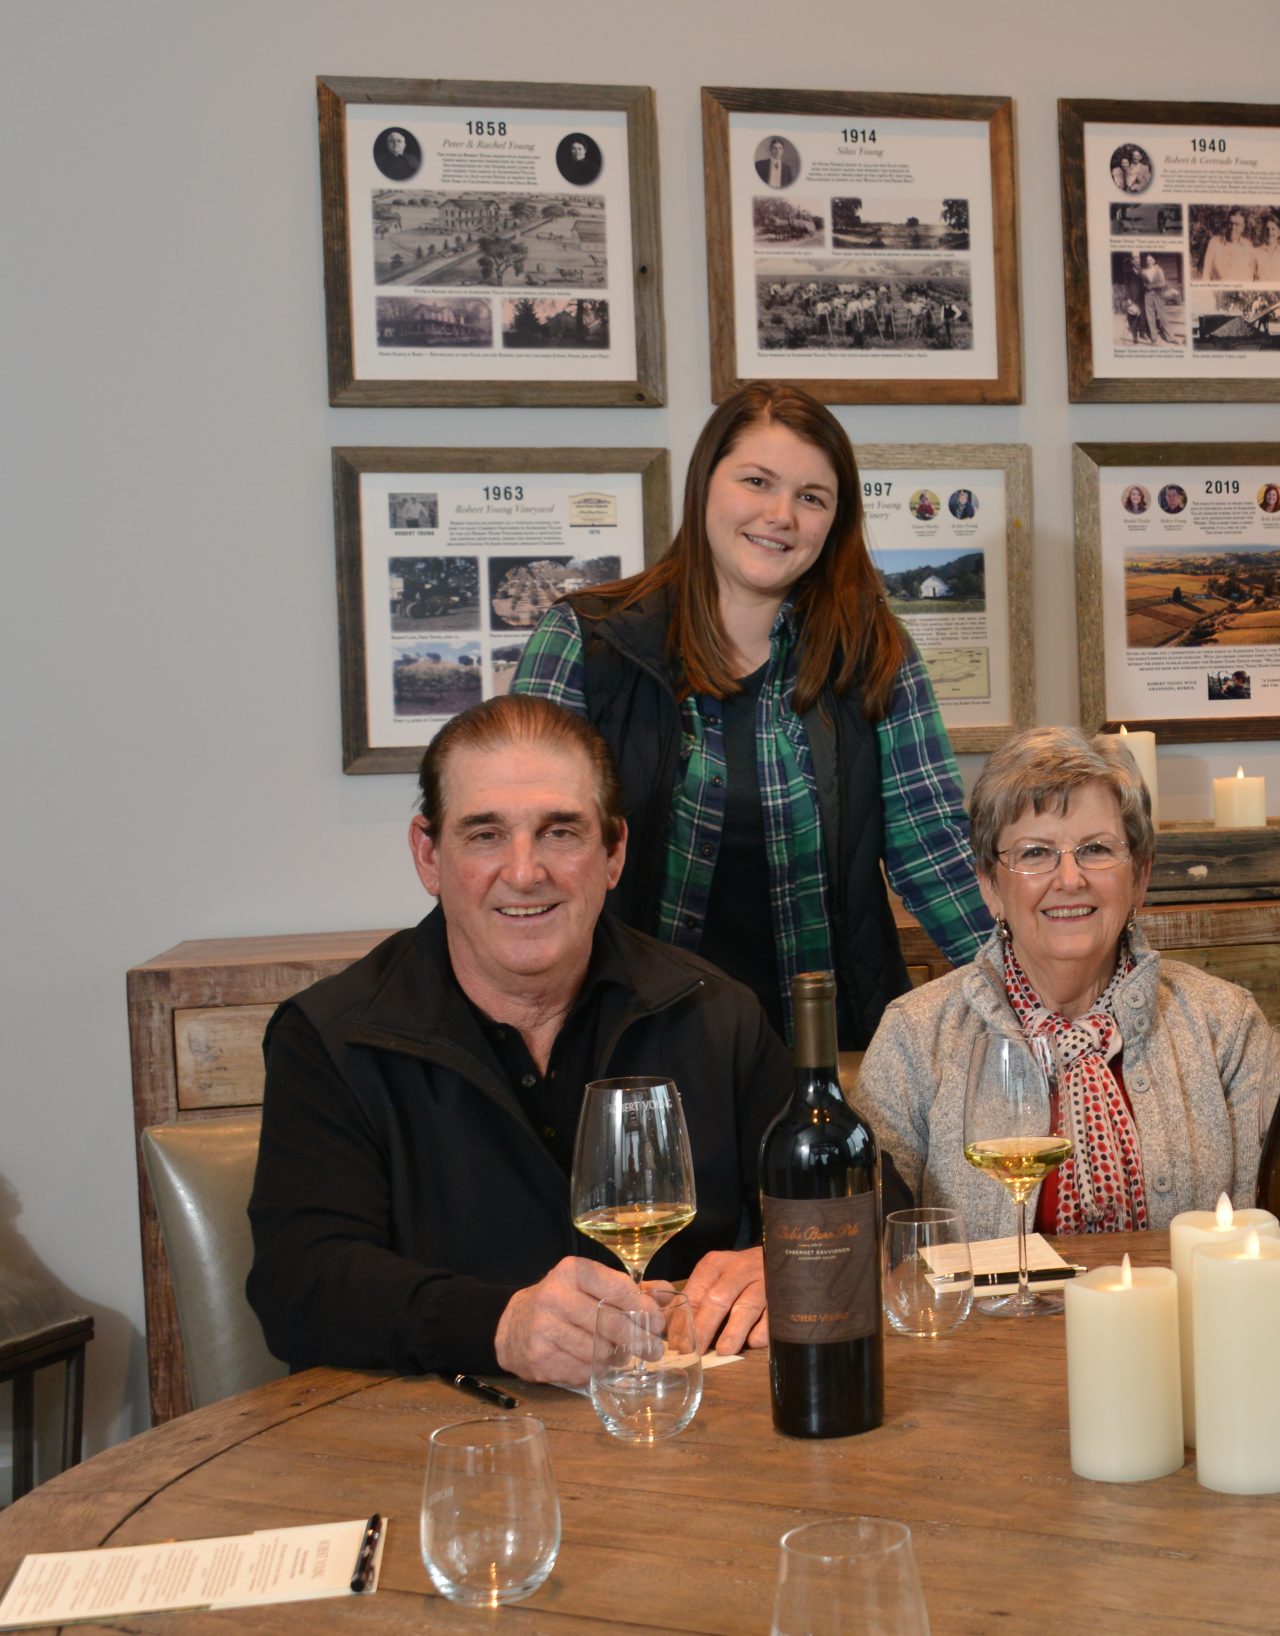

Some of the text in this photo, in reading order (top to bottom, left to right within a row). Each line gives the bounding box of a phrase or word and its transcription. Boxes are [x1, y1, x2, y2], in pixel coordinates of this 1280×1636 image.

[466, 120, 507, 136] 1858
[841, 128, 877, 143] 1914
[442, 139, 536, 153] Peter & Rachel Young
[836, 147, 885, 157] Silas Young
[1190, 138, 1227, 153] 1940
[1163, 155, 1190, 165] Robert
[1199, 156, 1234, 166] Gertrude
[1234, 157, 1259, 168] Young
[483, 486, 524, 501] 1963
[863, 482, 893, 497] 997
[1205, 480, 1240, 494] 2019
[455, 503, 556, 516] Robert Young Vineyard
[863, 501, 902, 512] ert Young
[606, 1099, 673, 1114] RERT YOG
[816, 1247, 851, 1255] SAUVIGNON
